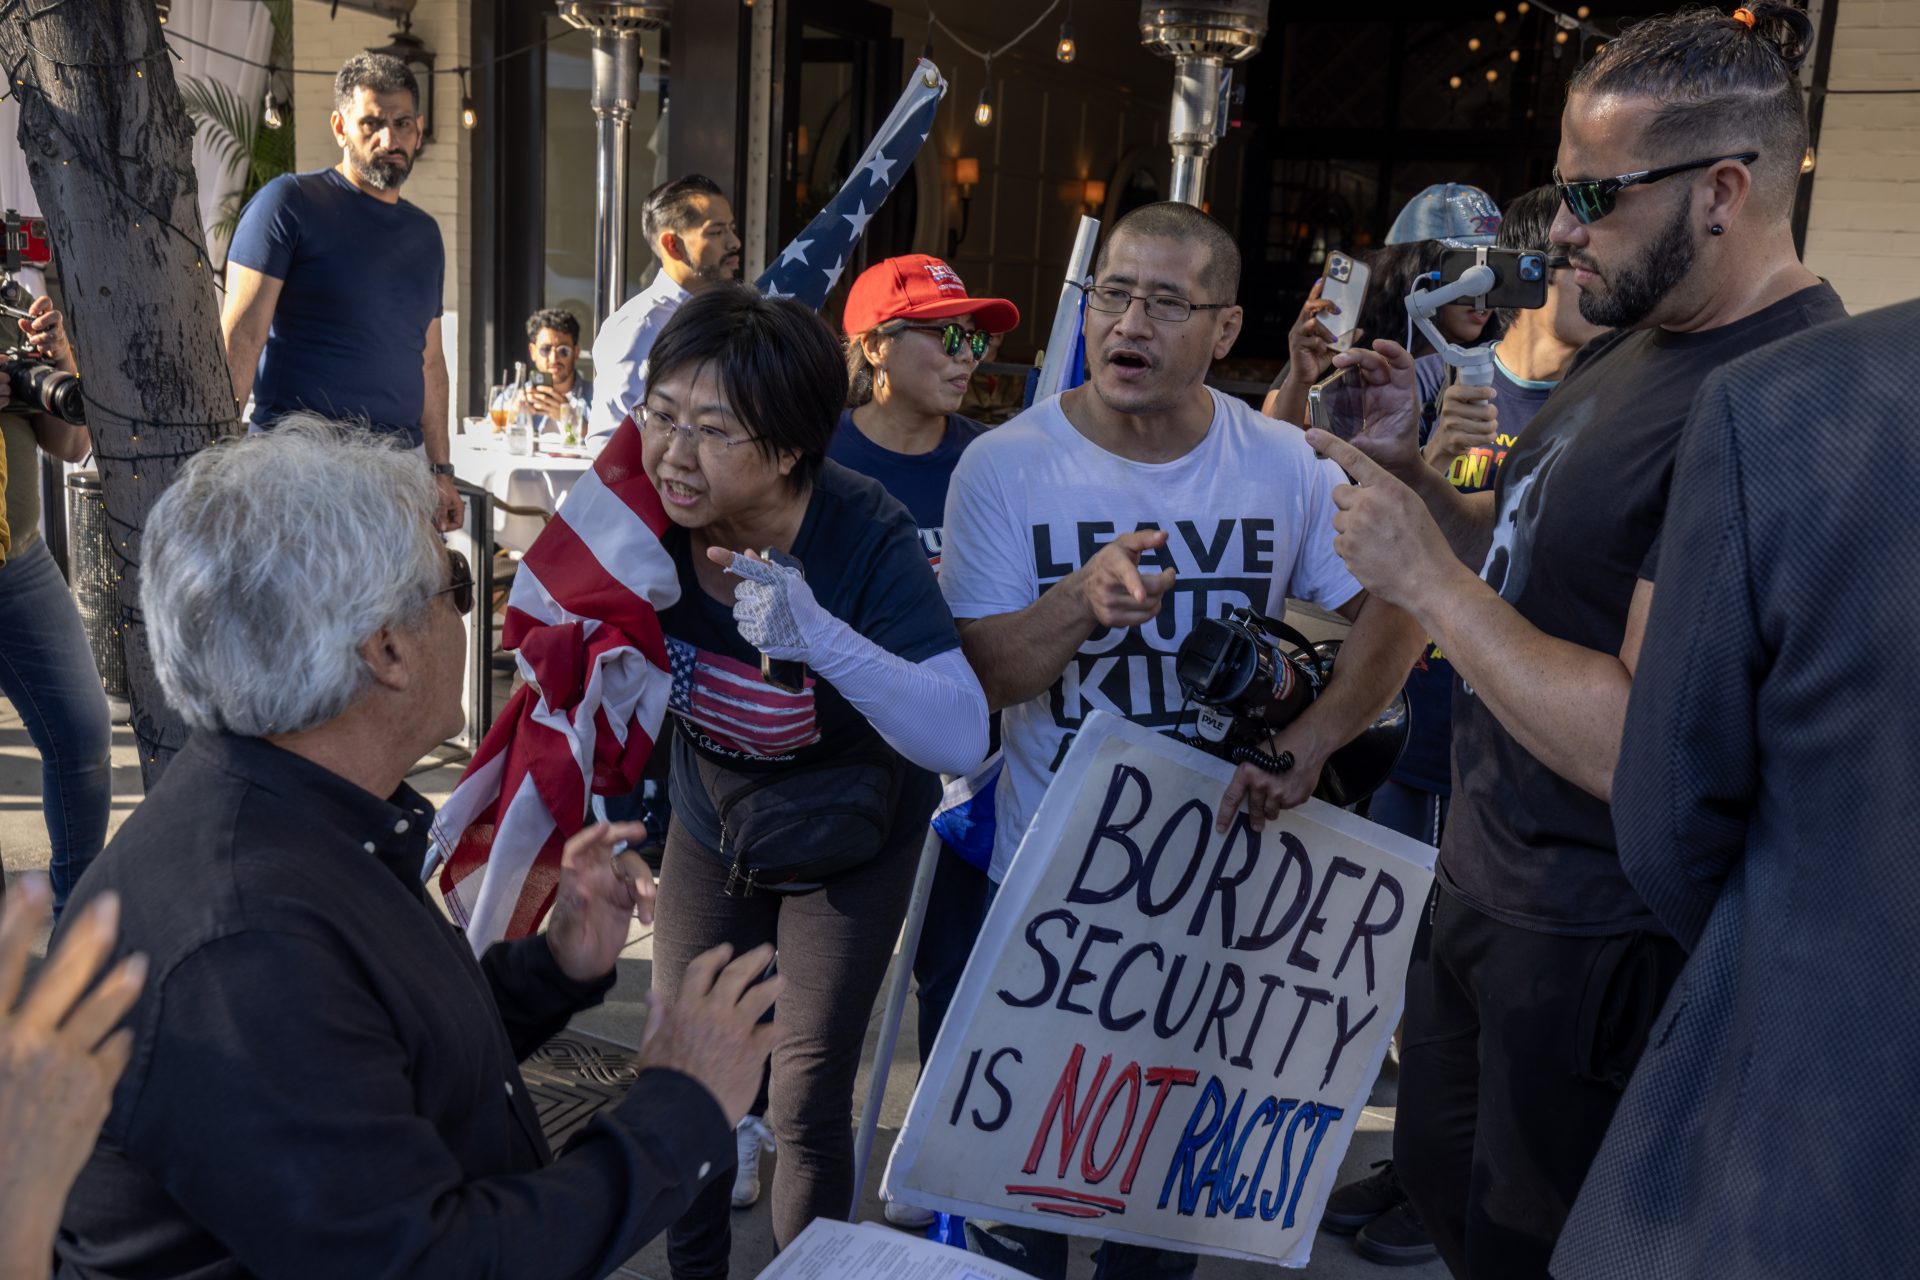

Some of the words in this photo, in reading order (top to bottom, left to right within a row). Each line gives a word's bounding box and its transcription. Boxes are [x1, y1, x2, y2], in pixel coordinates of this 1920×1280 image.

[1032, 518, 1275, 578] LEAVE
[1202, 713, 1225, 731] PYLE
[1066, 763, 1405, 997] BORDER
[996, 908, 1379, 1091] SECURITY
[948, 1046, 1024, 1133] IS
[1021, 1042, 1198, 1195] NOT
[1157, 1074, 1344, 1230] RACIST
